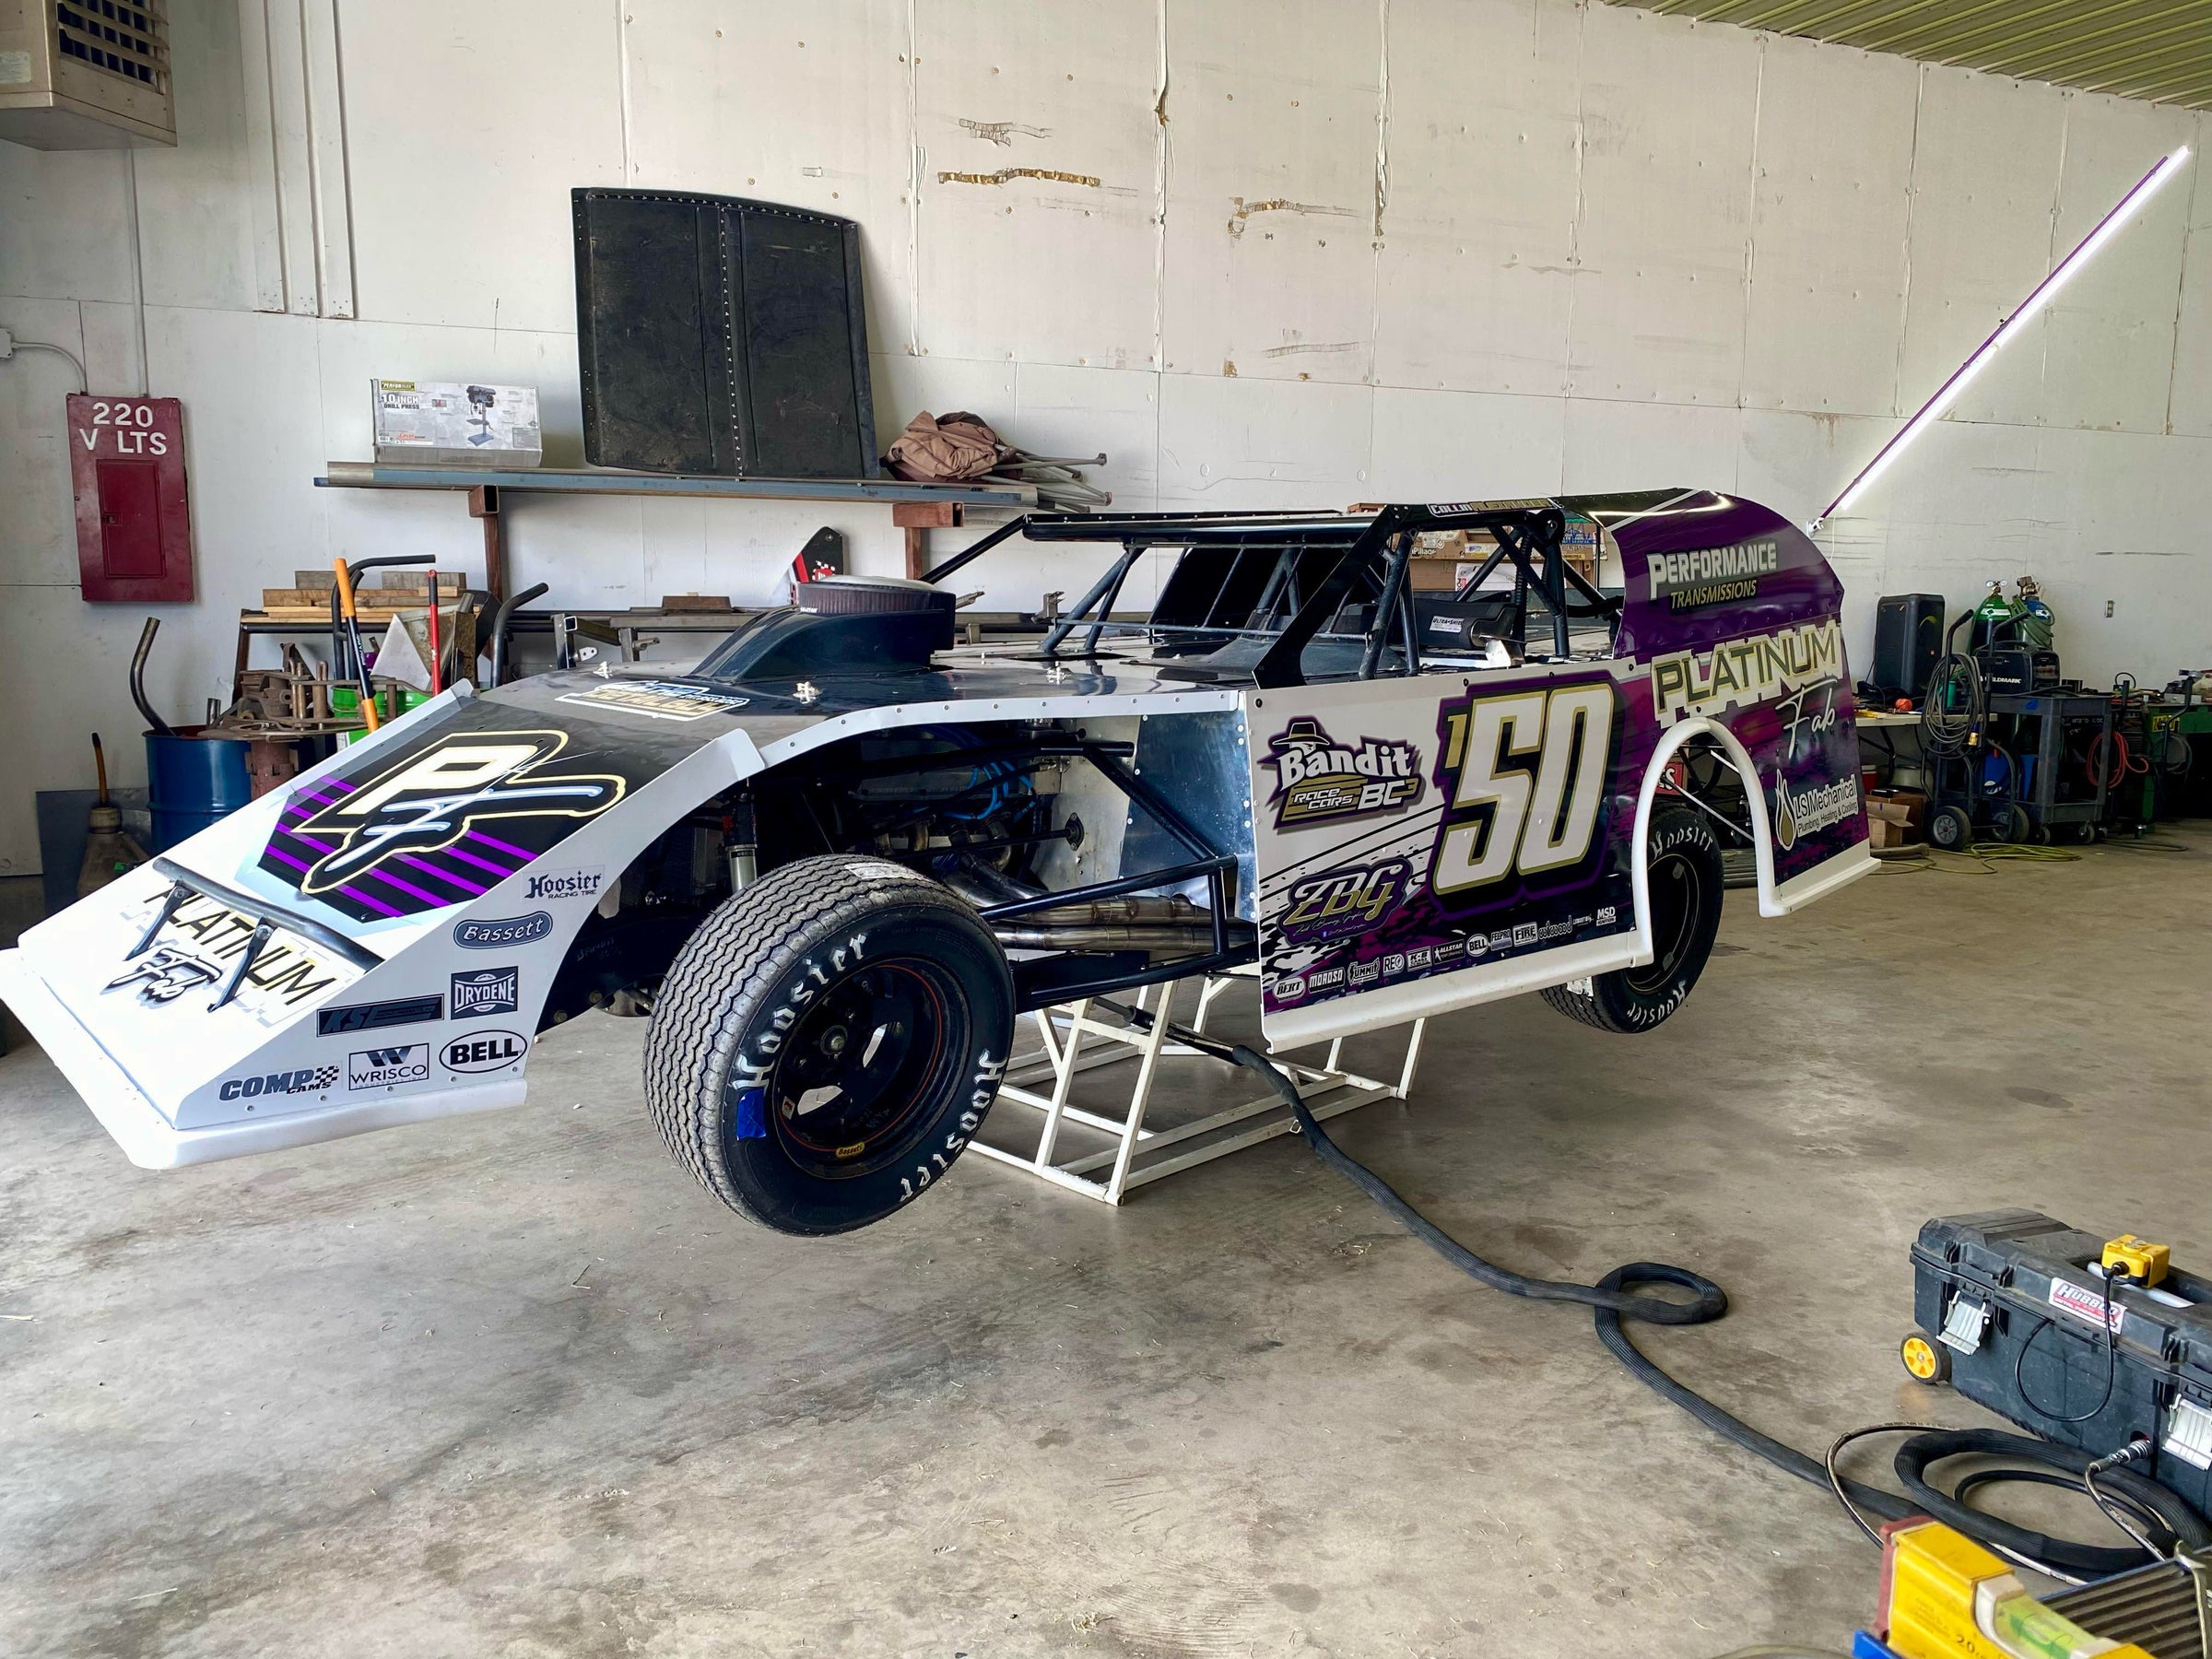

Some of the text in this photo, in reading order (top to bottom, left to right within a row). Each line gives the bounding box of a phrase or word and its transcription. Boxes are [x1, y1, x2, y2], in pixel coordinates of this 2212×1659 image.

[382, 394, 418, 404] 10 INCH
[92, 402, 153, 428] 220
[1430, 503, 1473, 515] COLLIN
[1648, 543, 1777, 599] PERFORMANCE
[1670, 580, 1758, 609] TRANSMISSIONS
[1656, 629, 1837, 712] PLATINUM
[1775, 677, 1839, 759] Fab
[1277, 743, 1413, 791] Bandit
[1820, 810, 1838, 823] Heating
[1841, 801, 1857, 815] Cooling
[525, 869, 602, 900] Hoosier
[548, 890, 578, 900] RACING
[1597, 906, 1616, 920] MSD
[464, 919, 545, 944] Bassett
[1440, 943, 1463, 953] ALLSTAR
[1469, 938, 1487, 951] BELL
[1309, 970, 1344, 988] MOROSO
[1348, 959, 1380, 984] SUMMIT
[454, 976, 515, 1010] DRYDENE
[1277, 982, 1302, 996] BERT
[733, 932, 866, 1091] Hoosier
[450, 1037, 521, 1064] BELL
[219, 1069, 314, 1102] COMP
[350, 1065, 427, 1084] WRISCO
[286, 1081, 332, 1095] CAMS
[900, 1050, 1007, 1202] Hoosier
